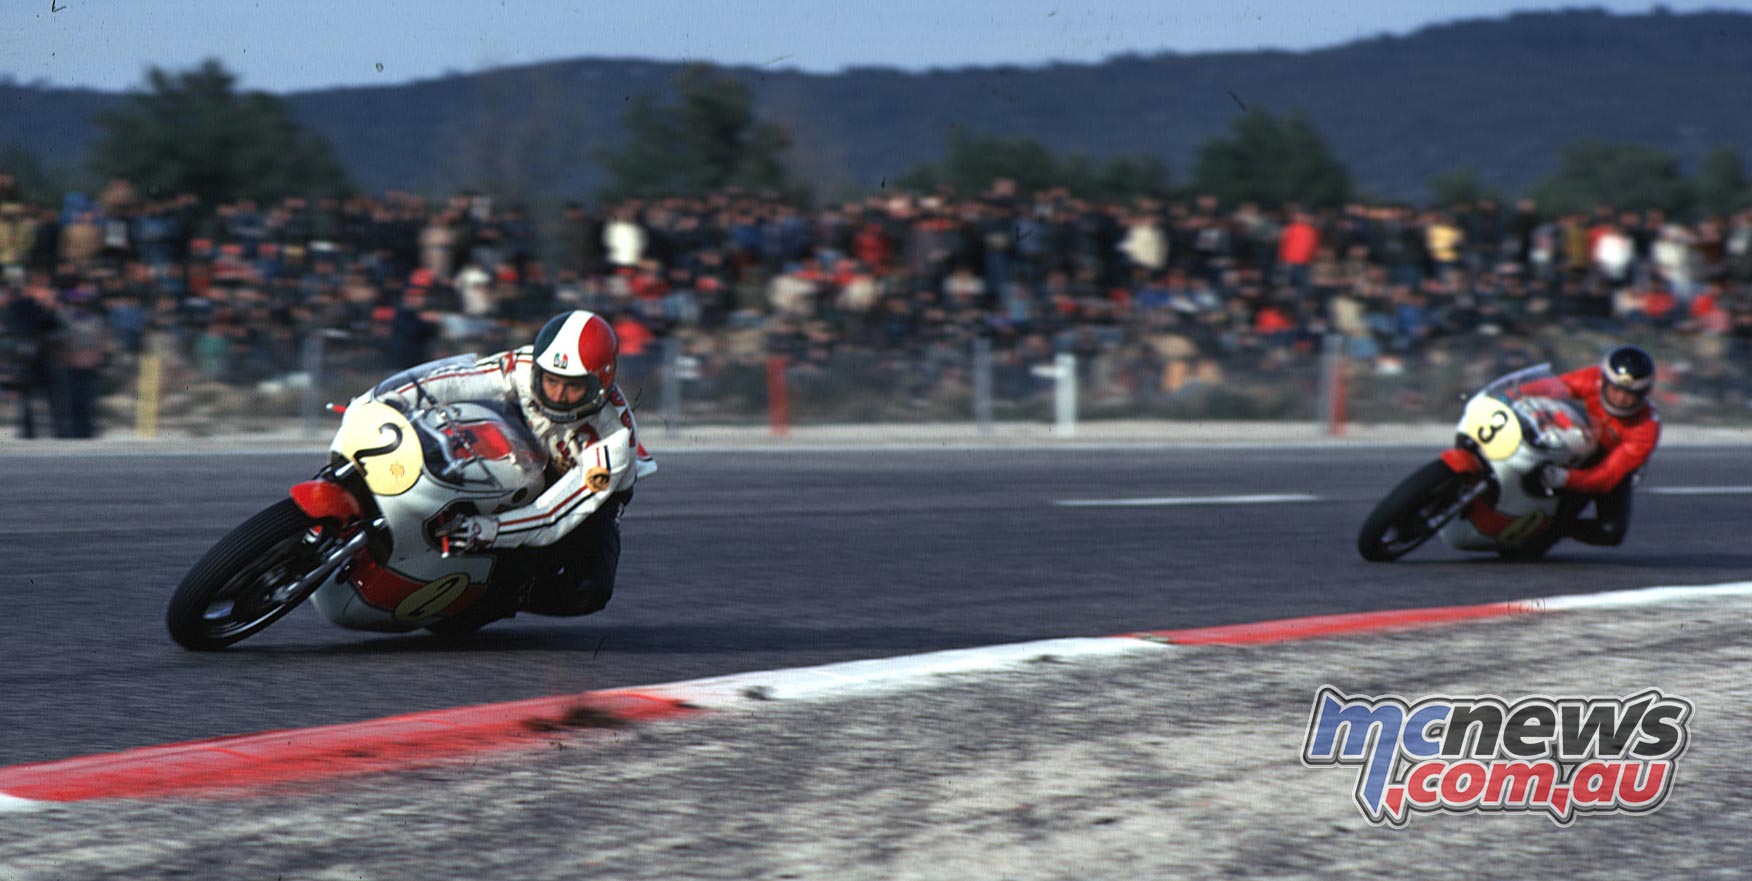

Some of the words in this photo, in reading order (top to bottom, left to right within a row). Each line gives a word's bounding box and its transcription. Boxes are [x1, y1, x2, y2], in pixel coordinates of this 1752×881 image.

[353, 422, 404, 462] 2
[1478, 410, 1508, 444] 3
[407, 576, 460, 617] 2
